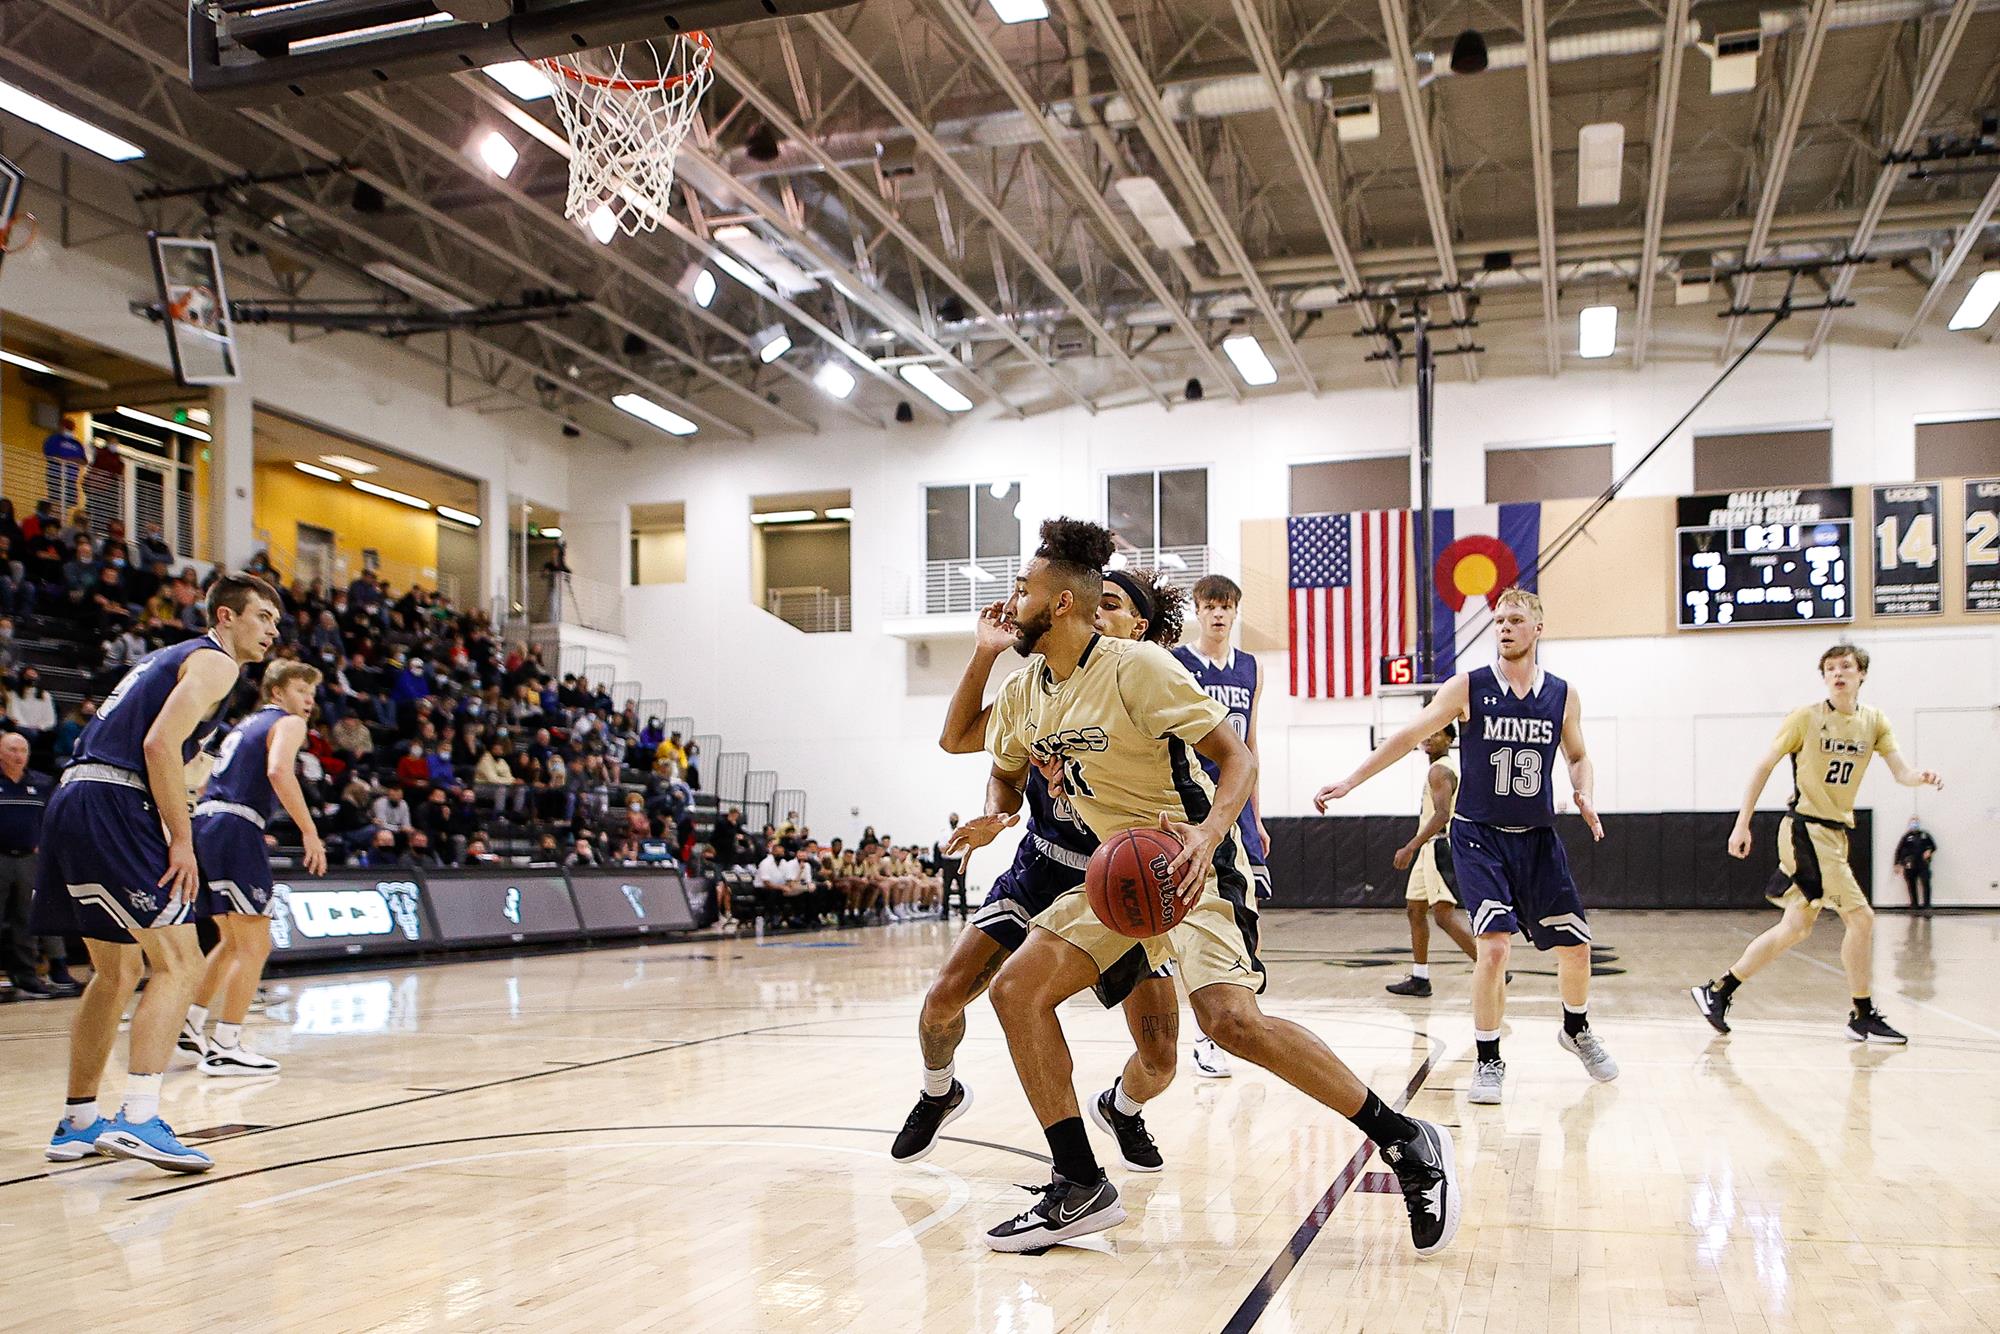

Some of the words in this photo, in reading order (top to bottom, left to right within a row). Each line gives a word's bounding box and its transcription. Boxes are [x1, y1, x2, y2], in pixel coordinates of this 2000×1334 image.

[1876, 513, 1937, 569] 14
[1965, 510, 2000, 565] 2
[1390, 658, 1410, 683] 15
[1483, 715, 1553, 744] MINES
[1490, 747, 1543, 797] 13
[1825, 759, 1855, 786] 20
